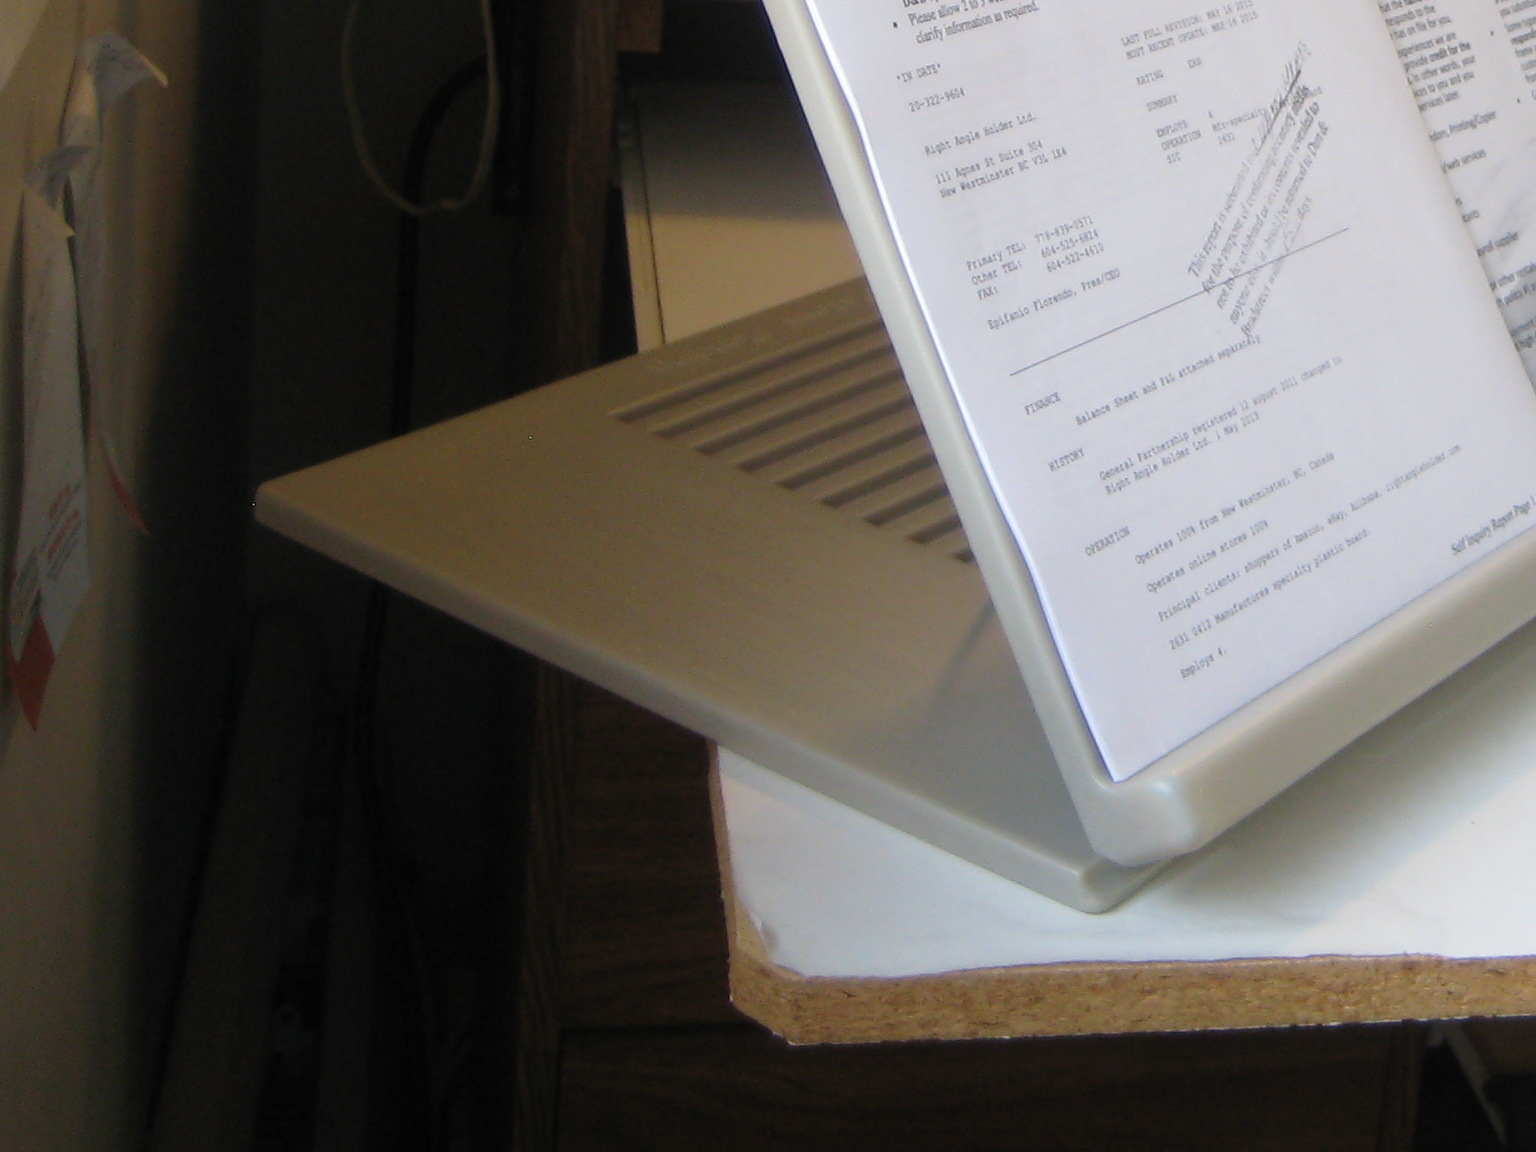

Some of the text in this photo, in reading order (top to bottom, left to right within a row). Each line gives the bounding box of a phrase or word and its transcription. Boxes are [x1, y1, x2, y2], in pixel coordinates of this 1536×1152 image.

[915, 25, 943, 43] clarify
[944, 15, 992, 35] information
[993, 11, 1003, 22] as
[924, 140, 951, 155] Right
[954, 131, 980, 145] Angle
[983, 120, 1013, 136] Holder
[954, 163, 980, 177] Agnes
[983, 157, 995, 167] St
[998, 148, 1024, 162] Suite
[939, 187, 956, 198] New
[959, 167, 1013, 190] Westminster
[1017, 159, 1029, 171] BC
[966, 242, 1025, 270] Primary TEL:
[971, 260, 1021, 285] Other TEL:
[976, 285, 997, 300] FAX:
[1075, 404, 1110, 425] Balance
[1113, 391, 1138, 407] Sheet
[1142, 380, 1157, 394] and
[1178, 354, 1214, 378] attached
[1217, 334, 1260, 359] separately
[1024, 392, 1060, 414] FINANCE
[1048, 448, 1083, 471] HISTORY
[1104, 477, 1130, 494] Right
[1133, 463, 1158, 480] Angle
[1160, 447, 1189, 465] Holder
[1223, 423, 1238, 434] May
[1085, 526, 1129, 555] OPERATION
[1147, 567, 1185, 592] Operates
[1188, 549, 1216, 570] online
[1219, 532, 1247, 552] stores
[1180, 654, 1214, 678] Employs
